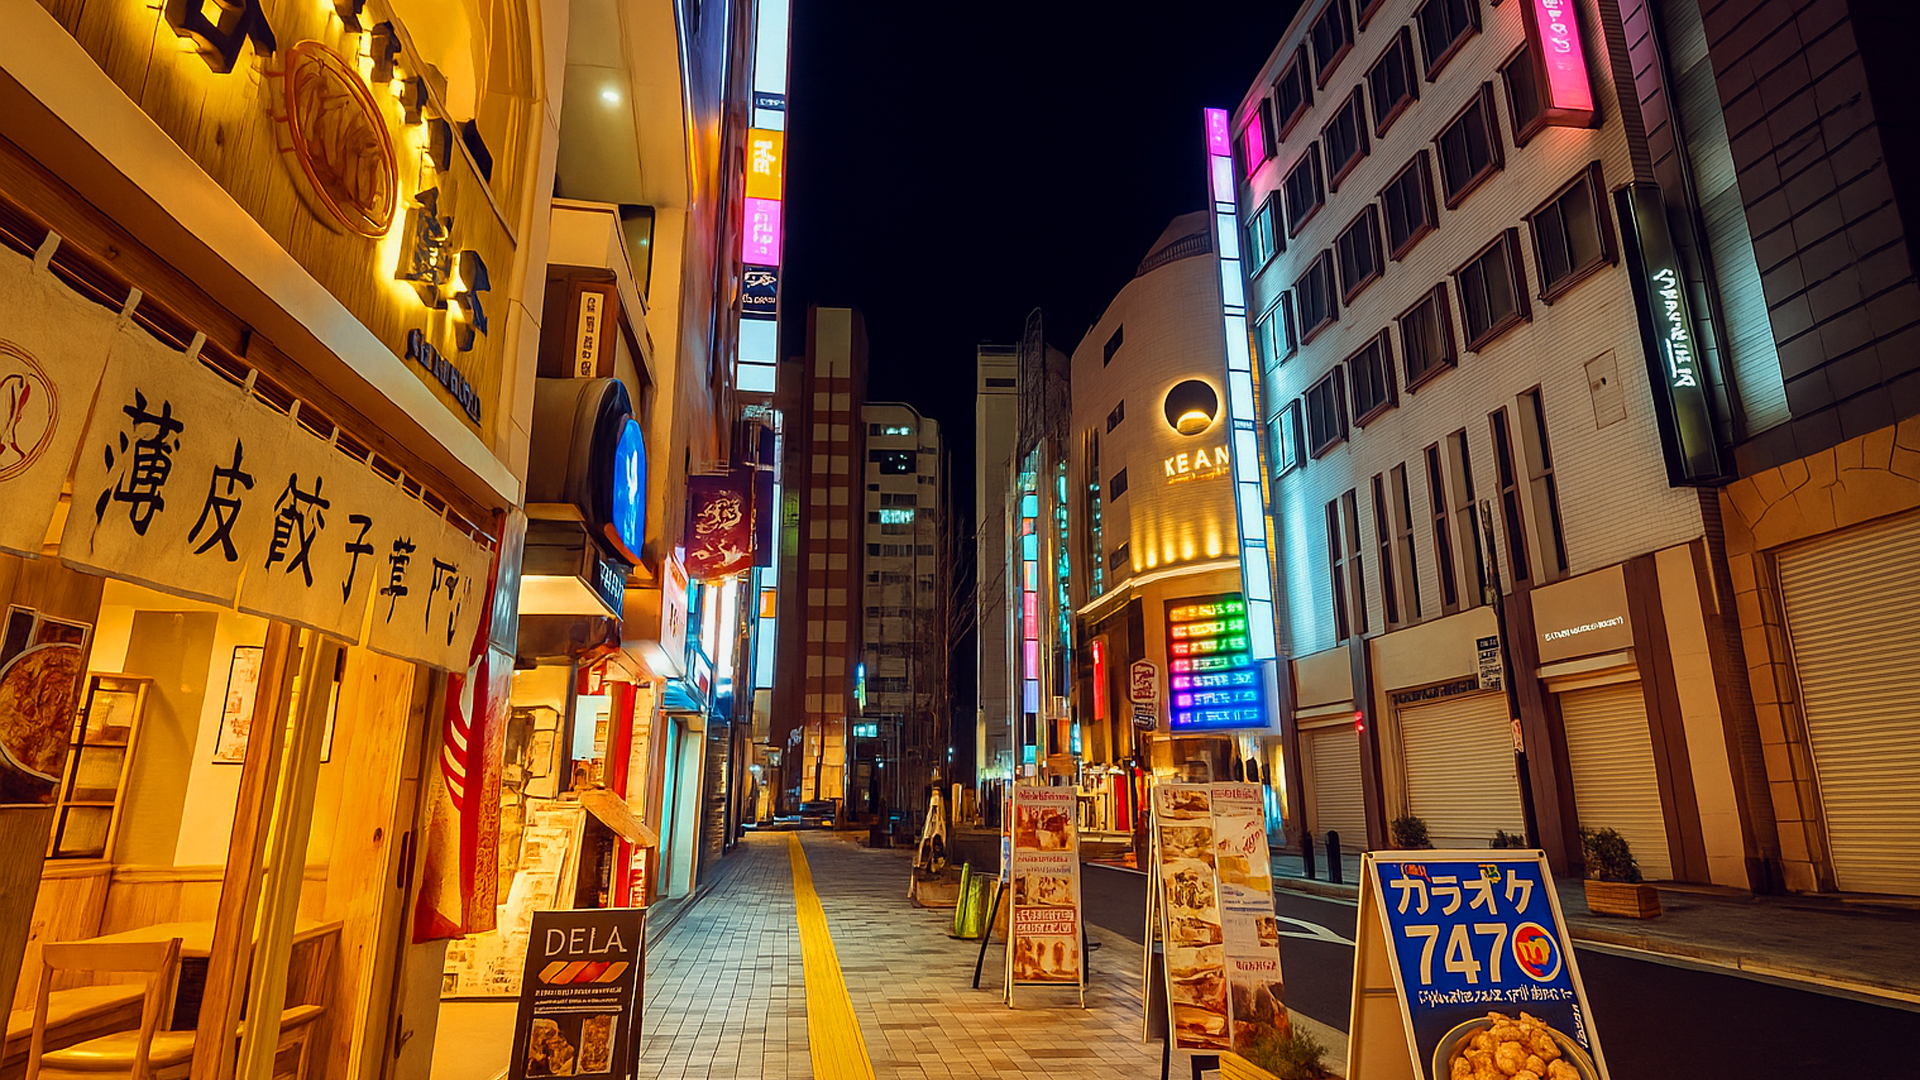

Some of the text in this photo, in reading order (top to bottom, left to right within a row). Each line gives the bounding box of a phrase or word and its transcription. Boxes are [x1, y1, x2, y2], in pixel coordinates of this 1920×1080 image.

[1389, 868, 1534, 916] カラオケ
[544, 926, 628, 957] DELA
[1404, 922, 1508, 986] 747
